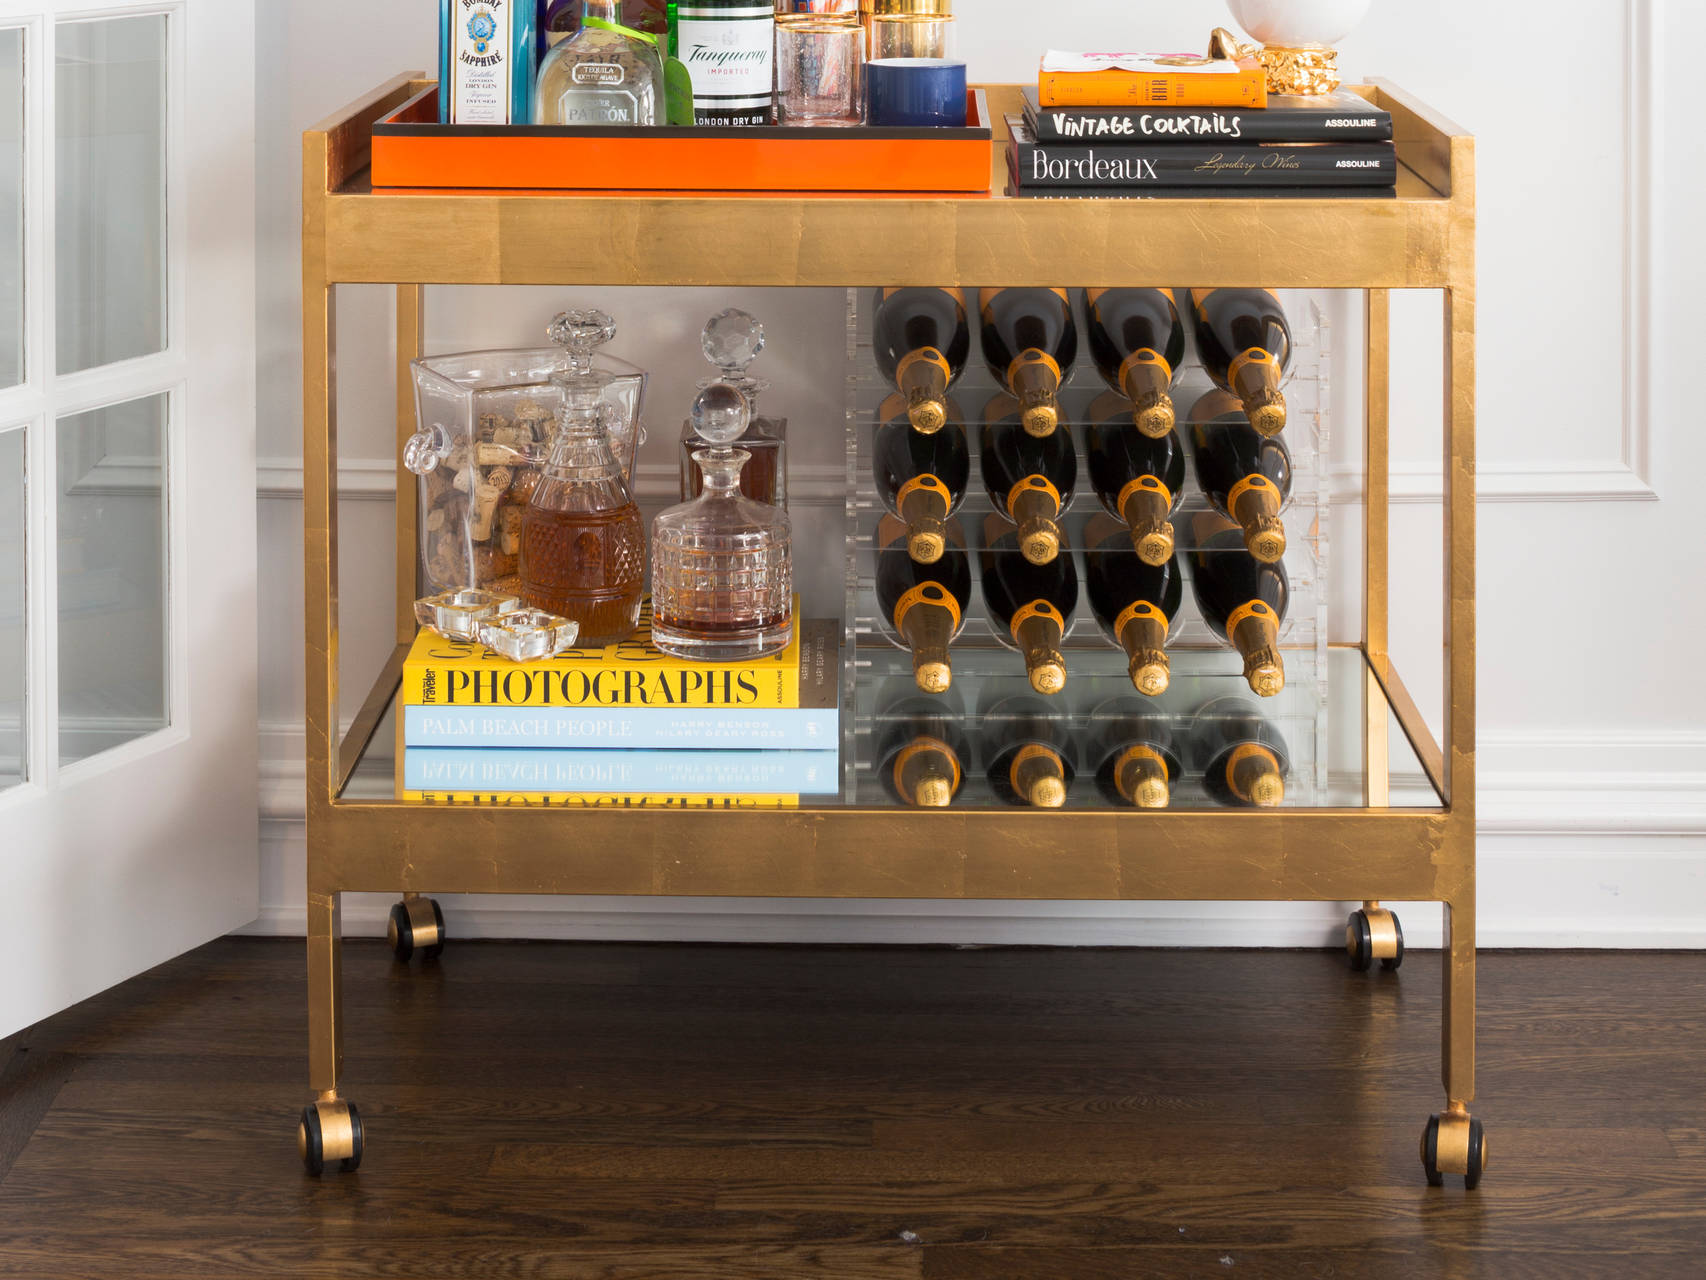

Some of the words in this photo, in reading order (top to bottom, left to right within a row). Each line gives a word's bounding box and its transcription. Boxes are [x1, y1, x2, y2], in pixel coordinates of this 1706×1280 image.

[459, 50, 503, 67] SAPPHIRE
[688, 44, 767, 66] Tanqueray
[584, 66, 615, 74] TEQUILA
[695, 117, 729, 126] LONDON
[733, 116, 749, 125] DRY
[752, 115, 764, 125] GIN
[1325, 119, 1377, 128] ASSOULINE
[1032, 149, 1158, 180] Bordeaux
[1194, 152, 1256, 175] Legendary
[1261, 152, 1300, 169] Wines
[1335, 160, 1380, 168] ASSOULINE
[422, 668, 436, 704] Traveler
[444, 670, 758, 704] PHOTOGRAPHS
[423, 718, 475, 735] PALM
[482, 720, 548, 736] BEACH
[556, 720, 632, 737] PEOPLE
